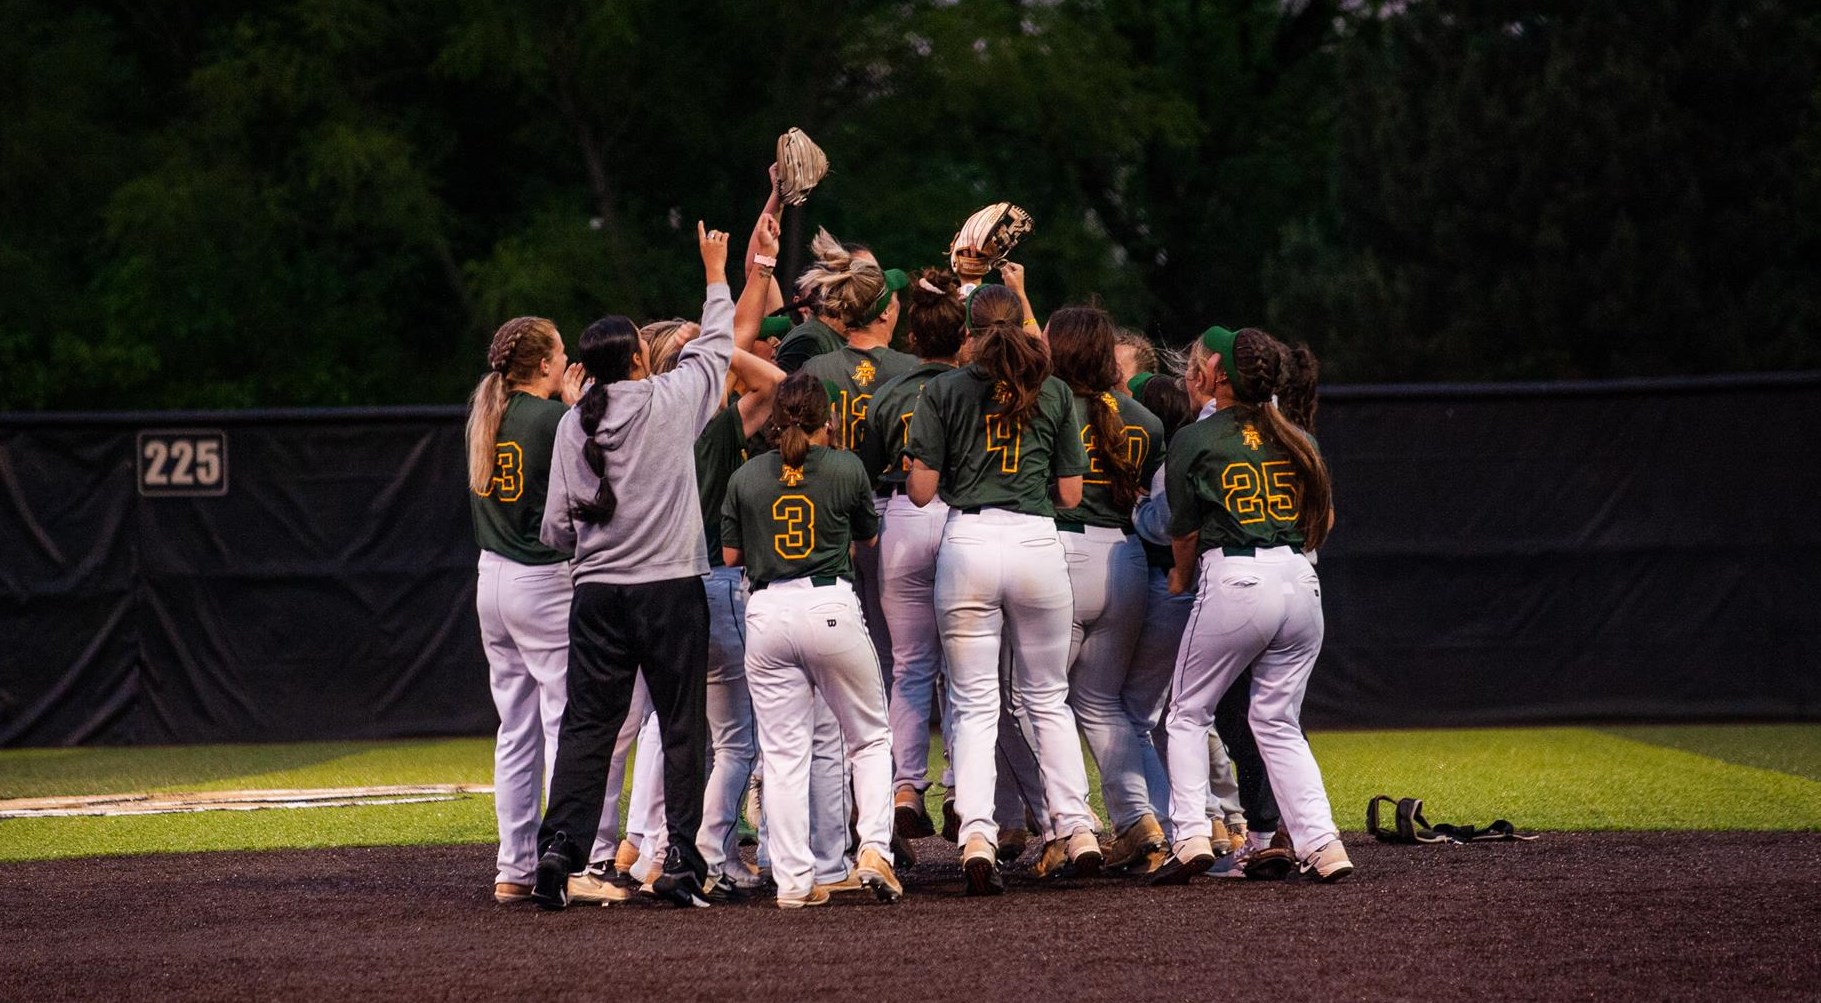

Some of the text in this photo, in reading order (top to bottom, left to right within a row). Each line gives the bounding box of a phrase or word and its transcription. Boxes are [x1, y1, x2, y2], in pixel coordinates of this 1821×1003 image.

[144, 440, 220, 485] 225
[985, 412, 1021, 473] 4
[1221, 461, 1299, 525] 25
[772, 494, 815, 560] 3
